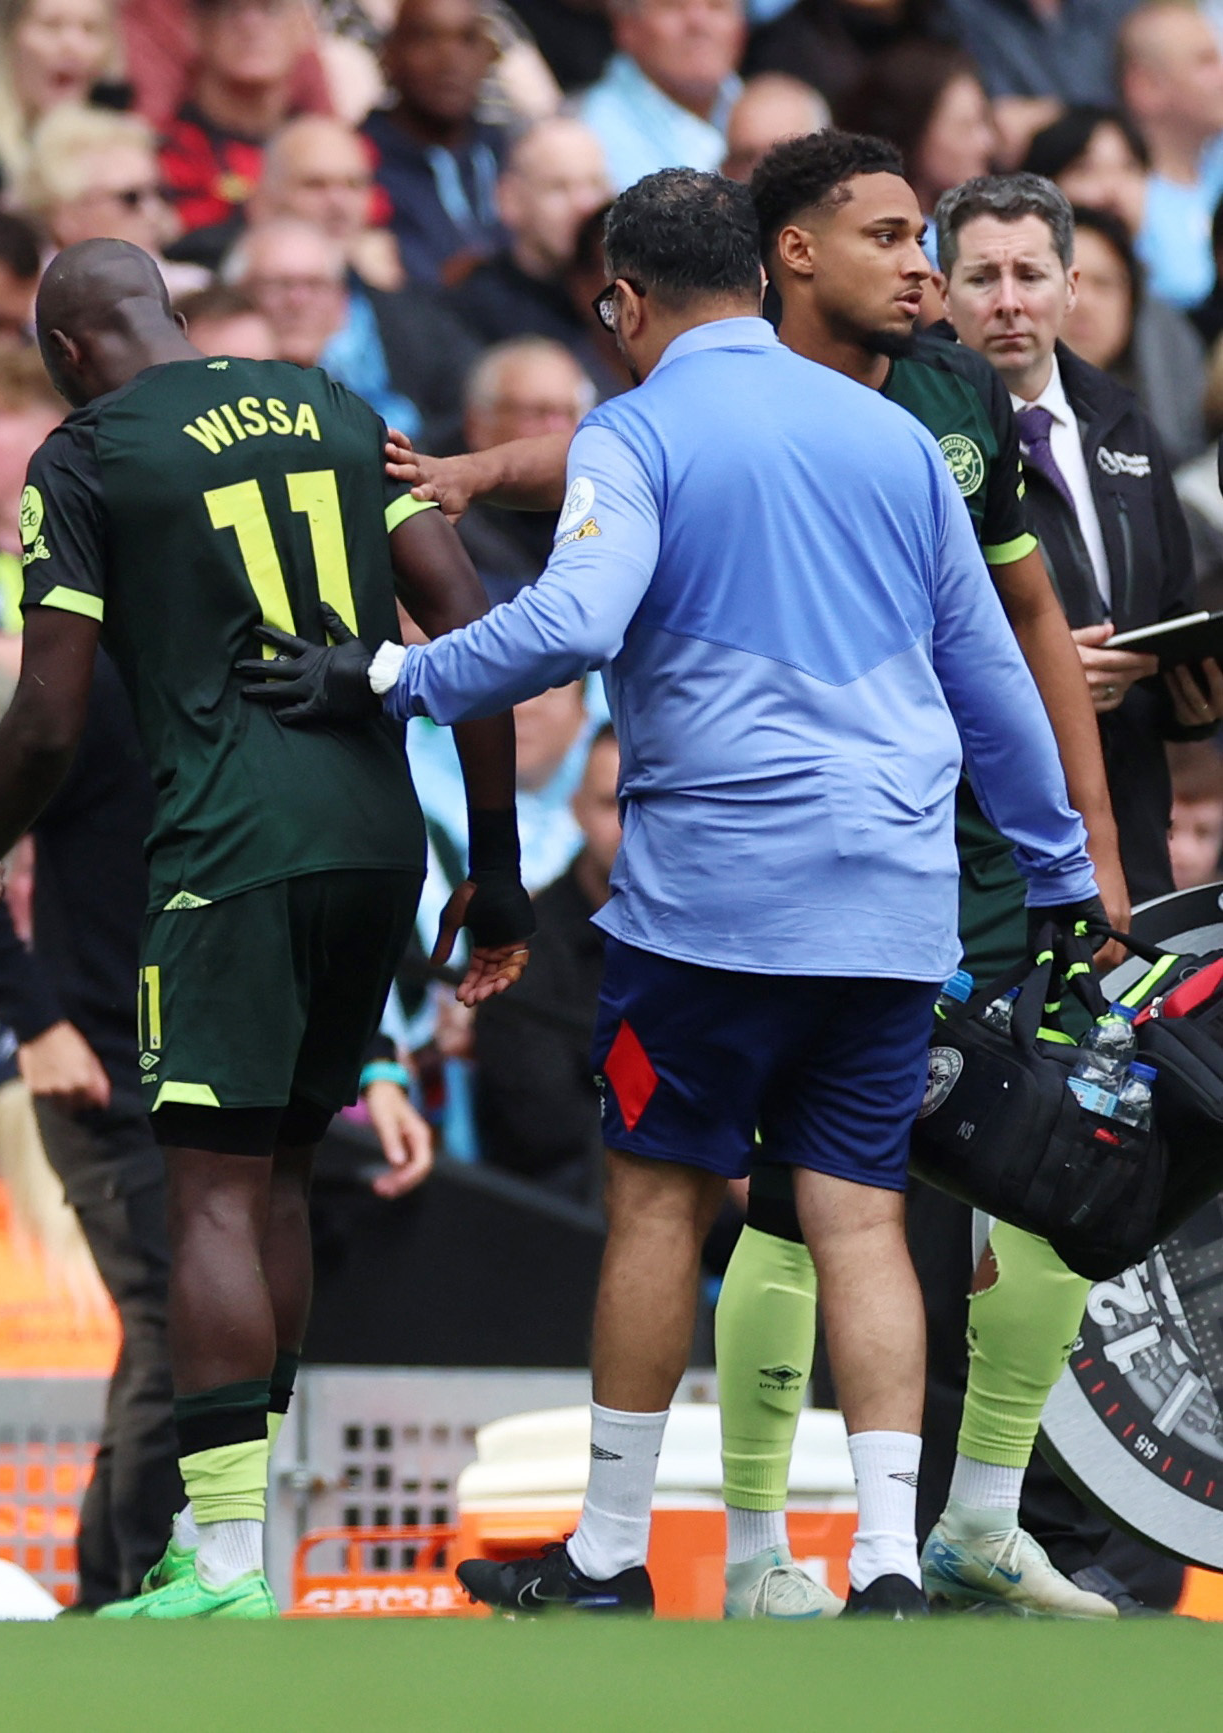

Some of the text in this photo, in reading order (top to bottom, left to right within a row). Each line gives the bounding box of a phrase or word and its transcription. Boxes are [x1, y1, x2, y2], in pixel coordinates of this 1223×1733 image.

[182, 396, 321, 455] WISSA
[203, 469, 359, 683] 11
[957, 1120, 976, 1140] NS
[303, 1586, 454, 1613] GATORA
